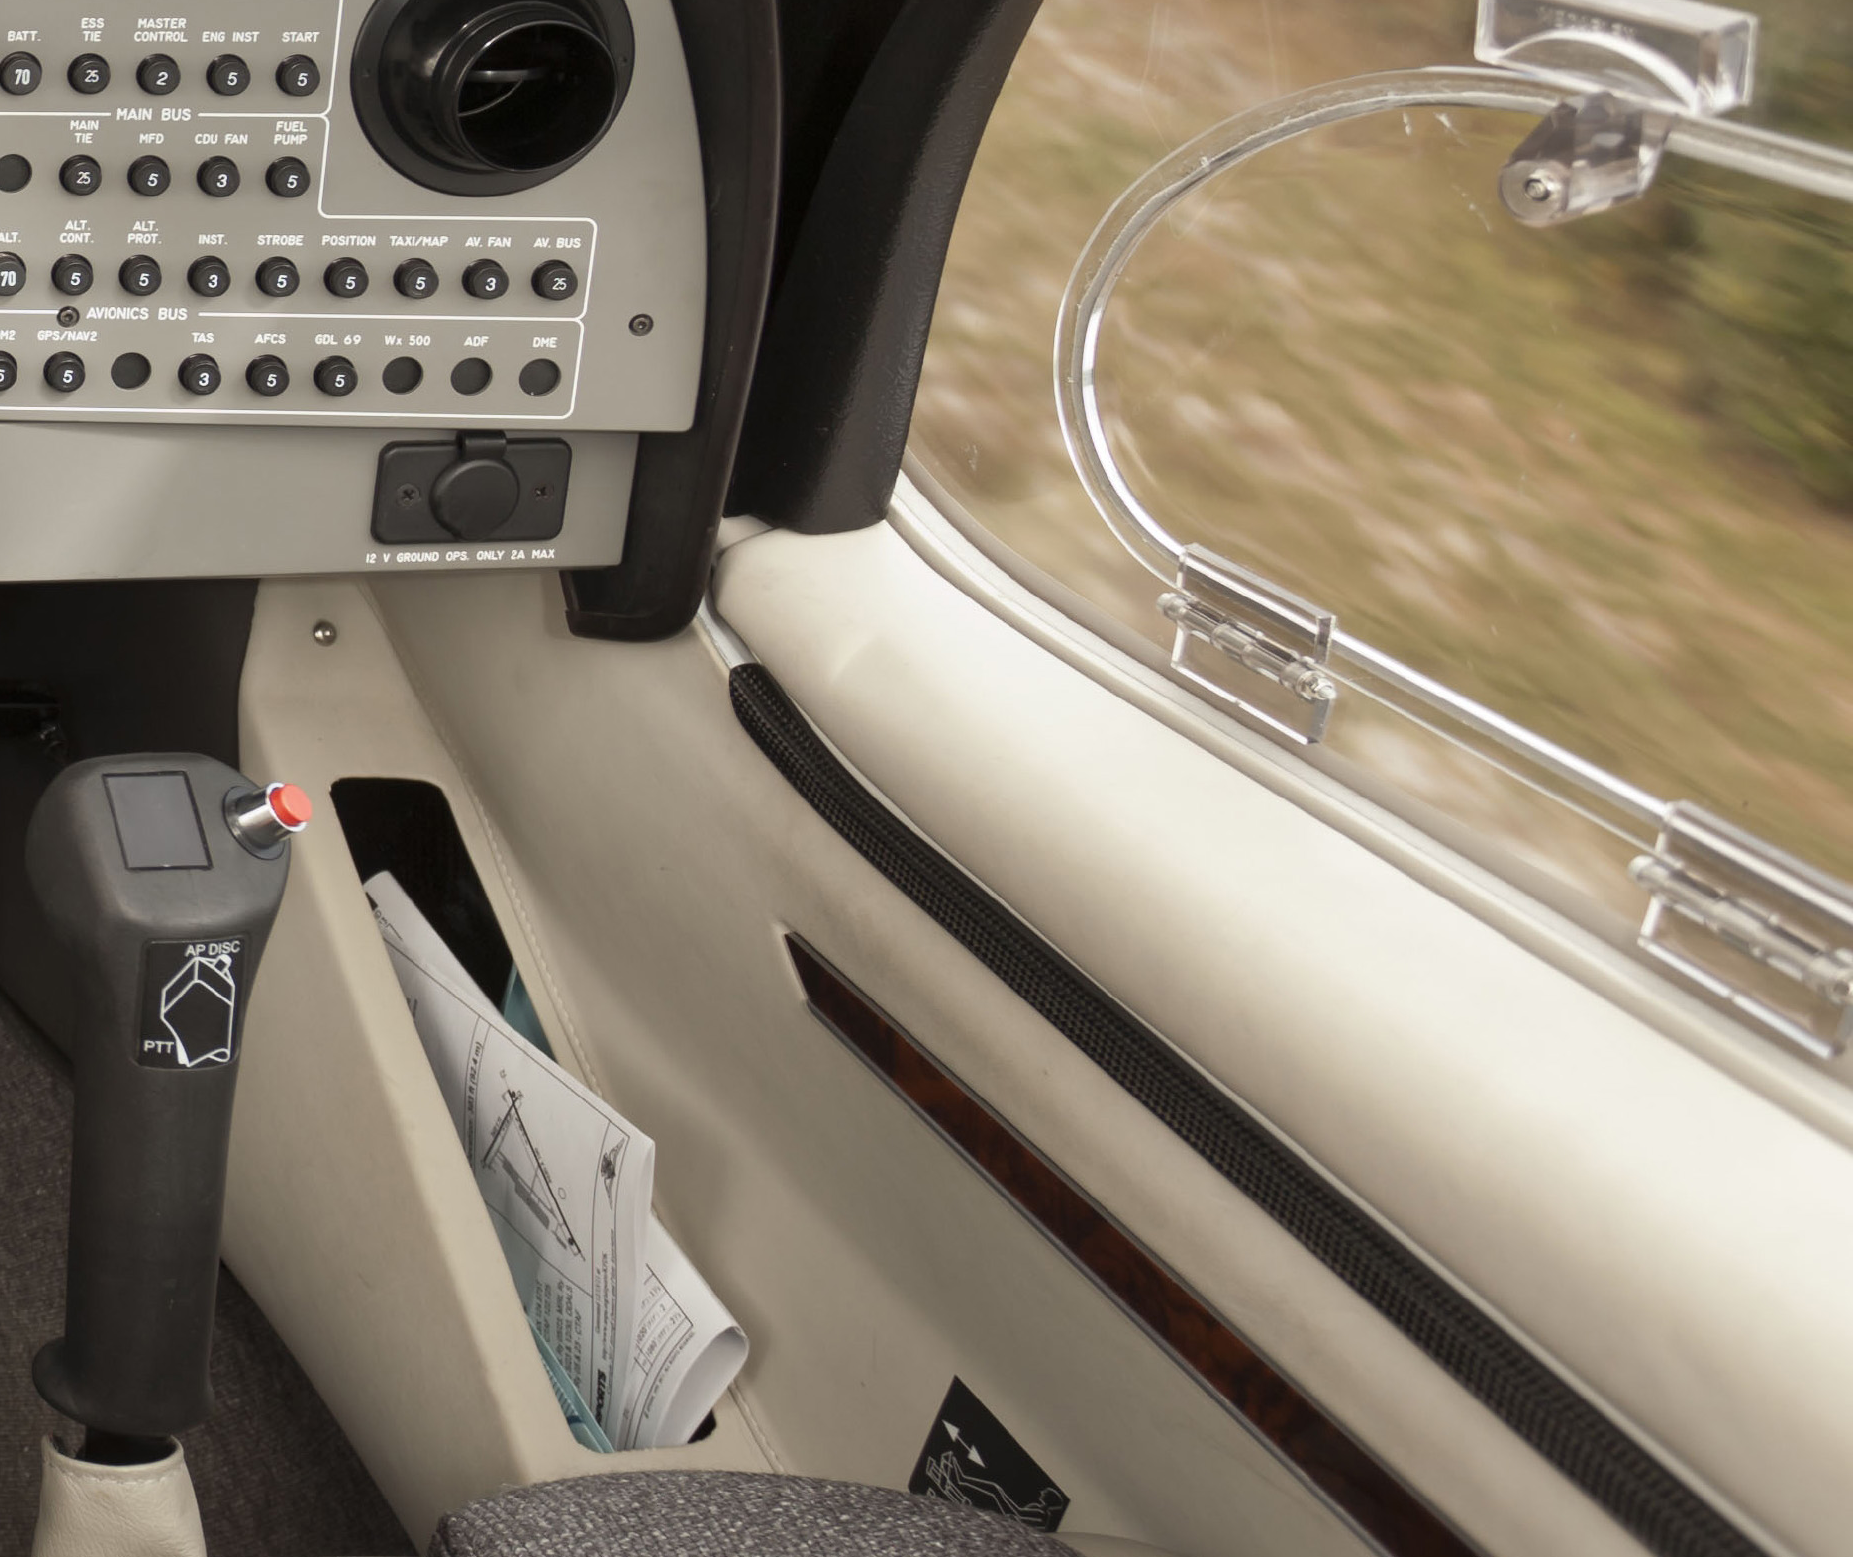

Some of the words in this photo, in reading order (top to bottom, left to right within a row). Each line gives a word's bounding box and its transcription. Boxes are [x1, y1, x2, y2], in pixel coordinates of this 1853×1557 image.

[117, 108, 158, 120] MAIN
[162, 108, 191, 121] BUS
[140, 133, 164, 144] MFD
[390, 236, 448, 246] TAXI/MAP
[86, 307, 148, 320] AVIONICS
[158, 308, 187, 320] BUS
[384, 554, 390, 562] V
[397, 552, 439, 562] GROUND
[477, 551, 505, 560] ONLY
[511, 550, 525, 559] 2A
[532, 549, 554, 558] MAX
[185, 944, 205, 956] AP
[209, 940, 240, 955] DISC
[144, 1040, 174, 1053] PTT
